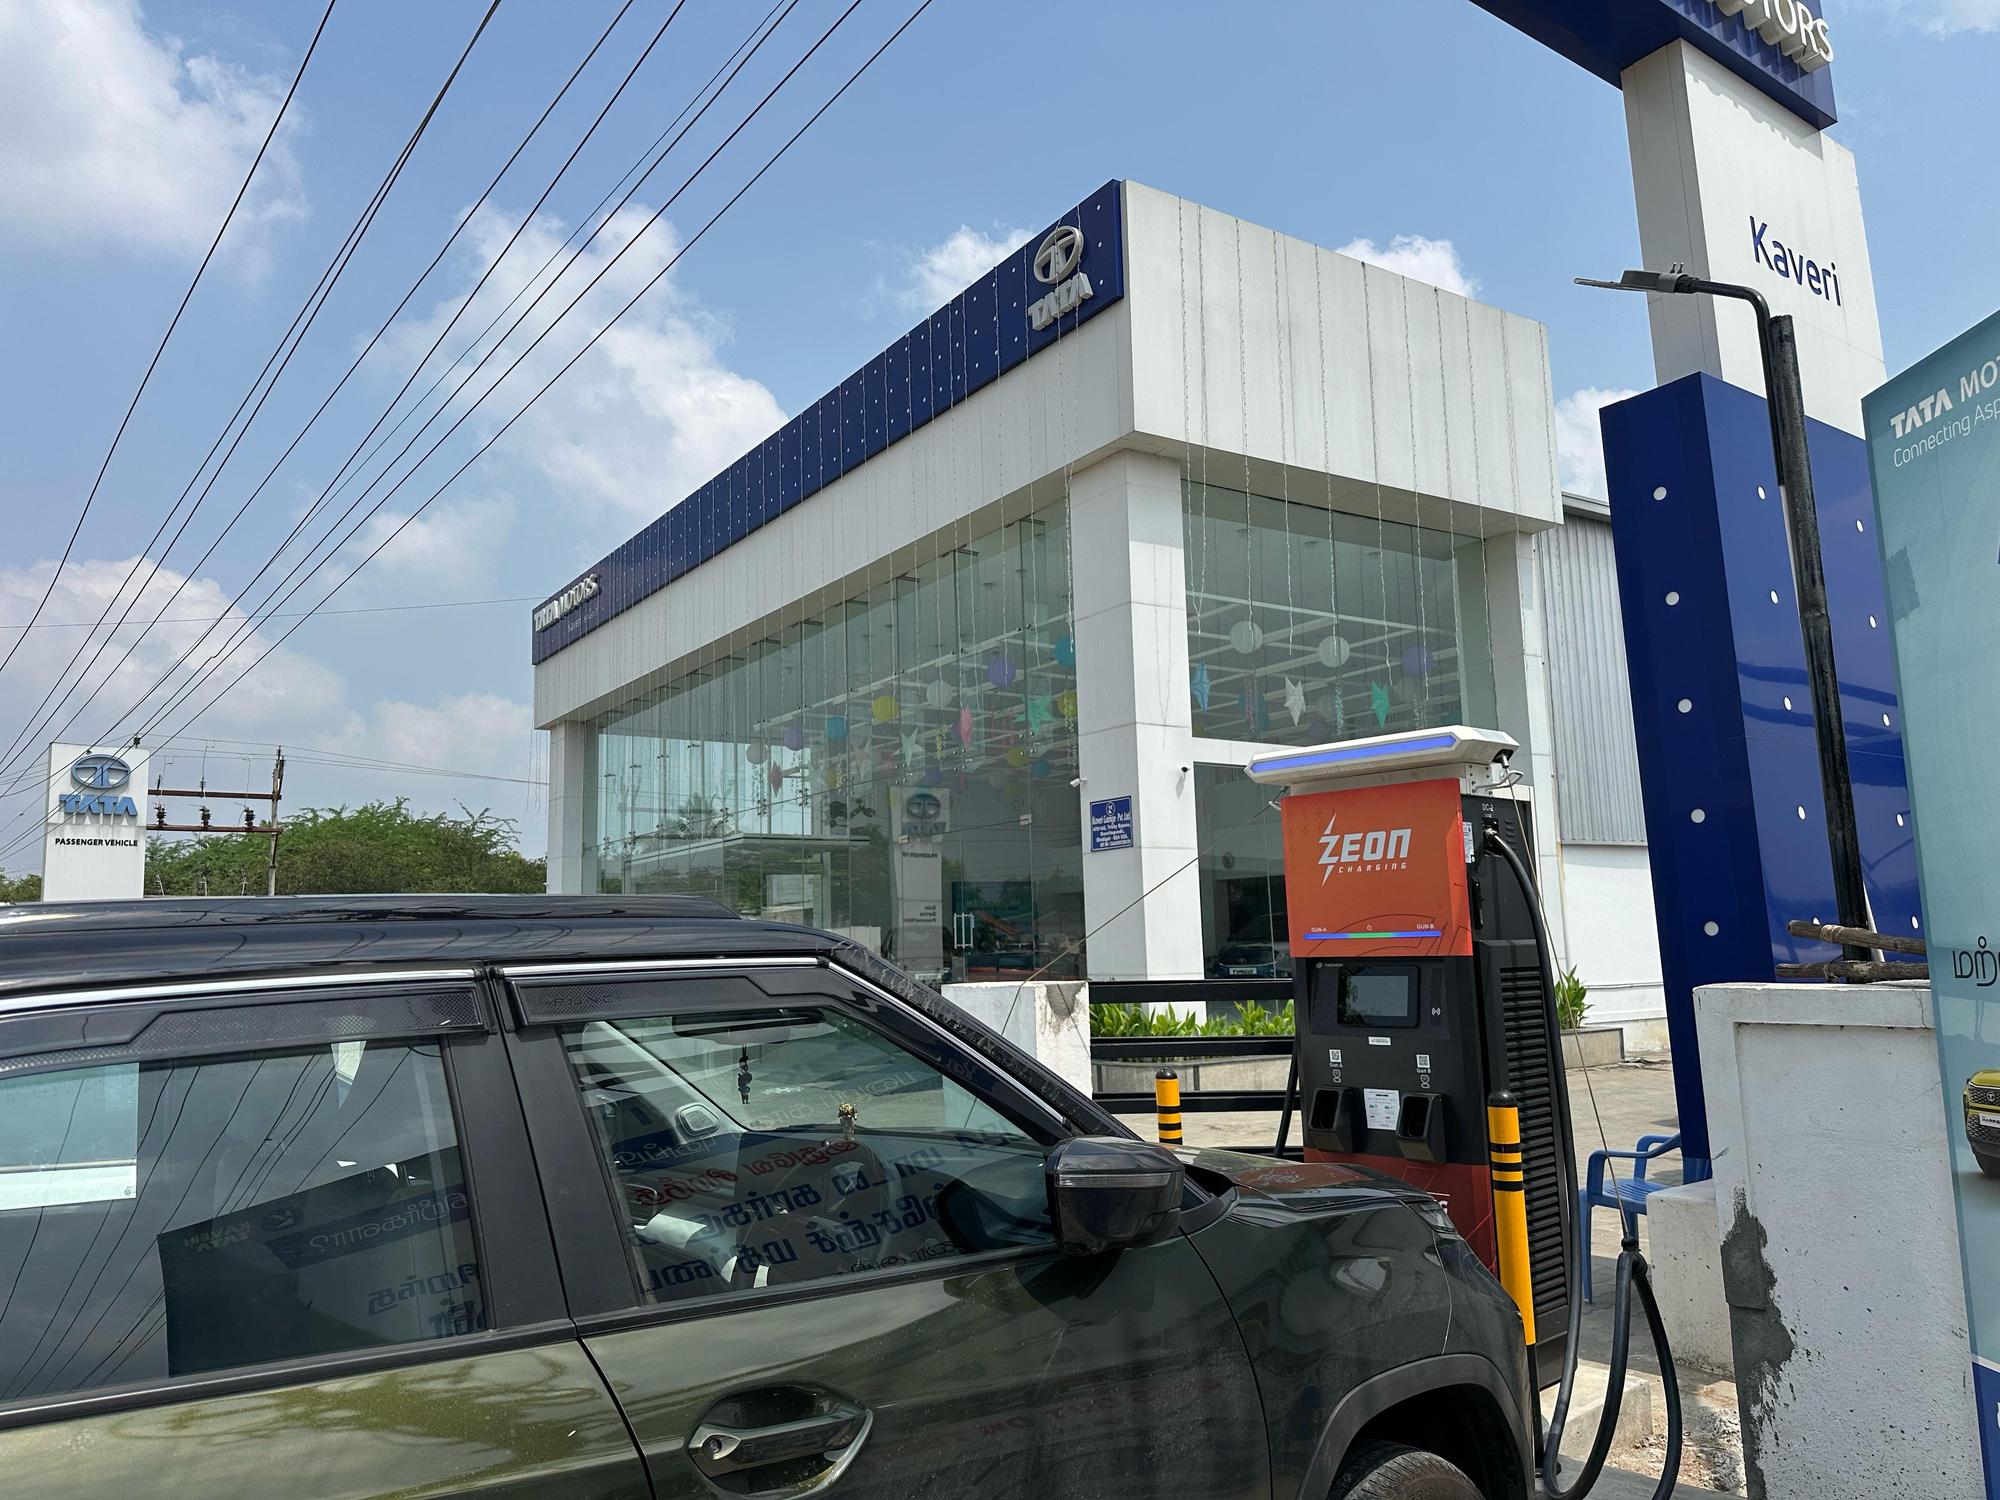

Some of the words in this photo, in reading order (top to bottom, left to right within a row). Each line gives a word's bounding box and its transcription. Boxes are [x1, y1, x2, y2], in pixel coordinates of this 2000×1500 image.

[1749, 215, 1842, 307] Kaveri
[1028, 272, 1094, 330] TATA
[1890, 388, 1954, 440] TATA
[1960, 354, 2000, 403] MO
[1893, 415, 1970, 468] Connecting
[534, 600, 560, 632] TATA
[559, 573, 598, 615] MOTORS
[59, 793, 139, 817] TATA
[1482, 803, 1494, 812] DC-2
[55, 837, 104, 847] PASSENGER
[104, 839, 139, 847] VEHICLE
[1318, 828, 1412, 865] ZEON
[1338, 862, 1408, 874] CHARGING
[1952, 935, 2000, 987] மற்
